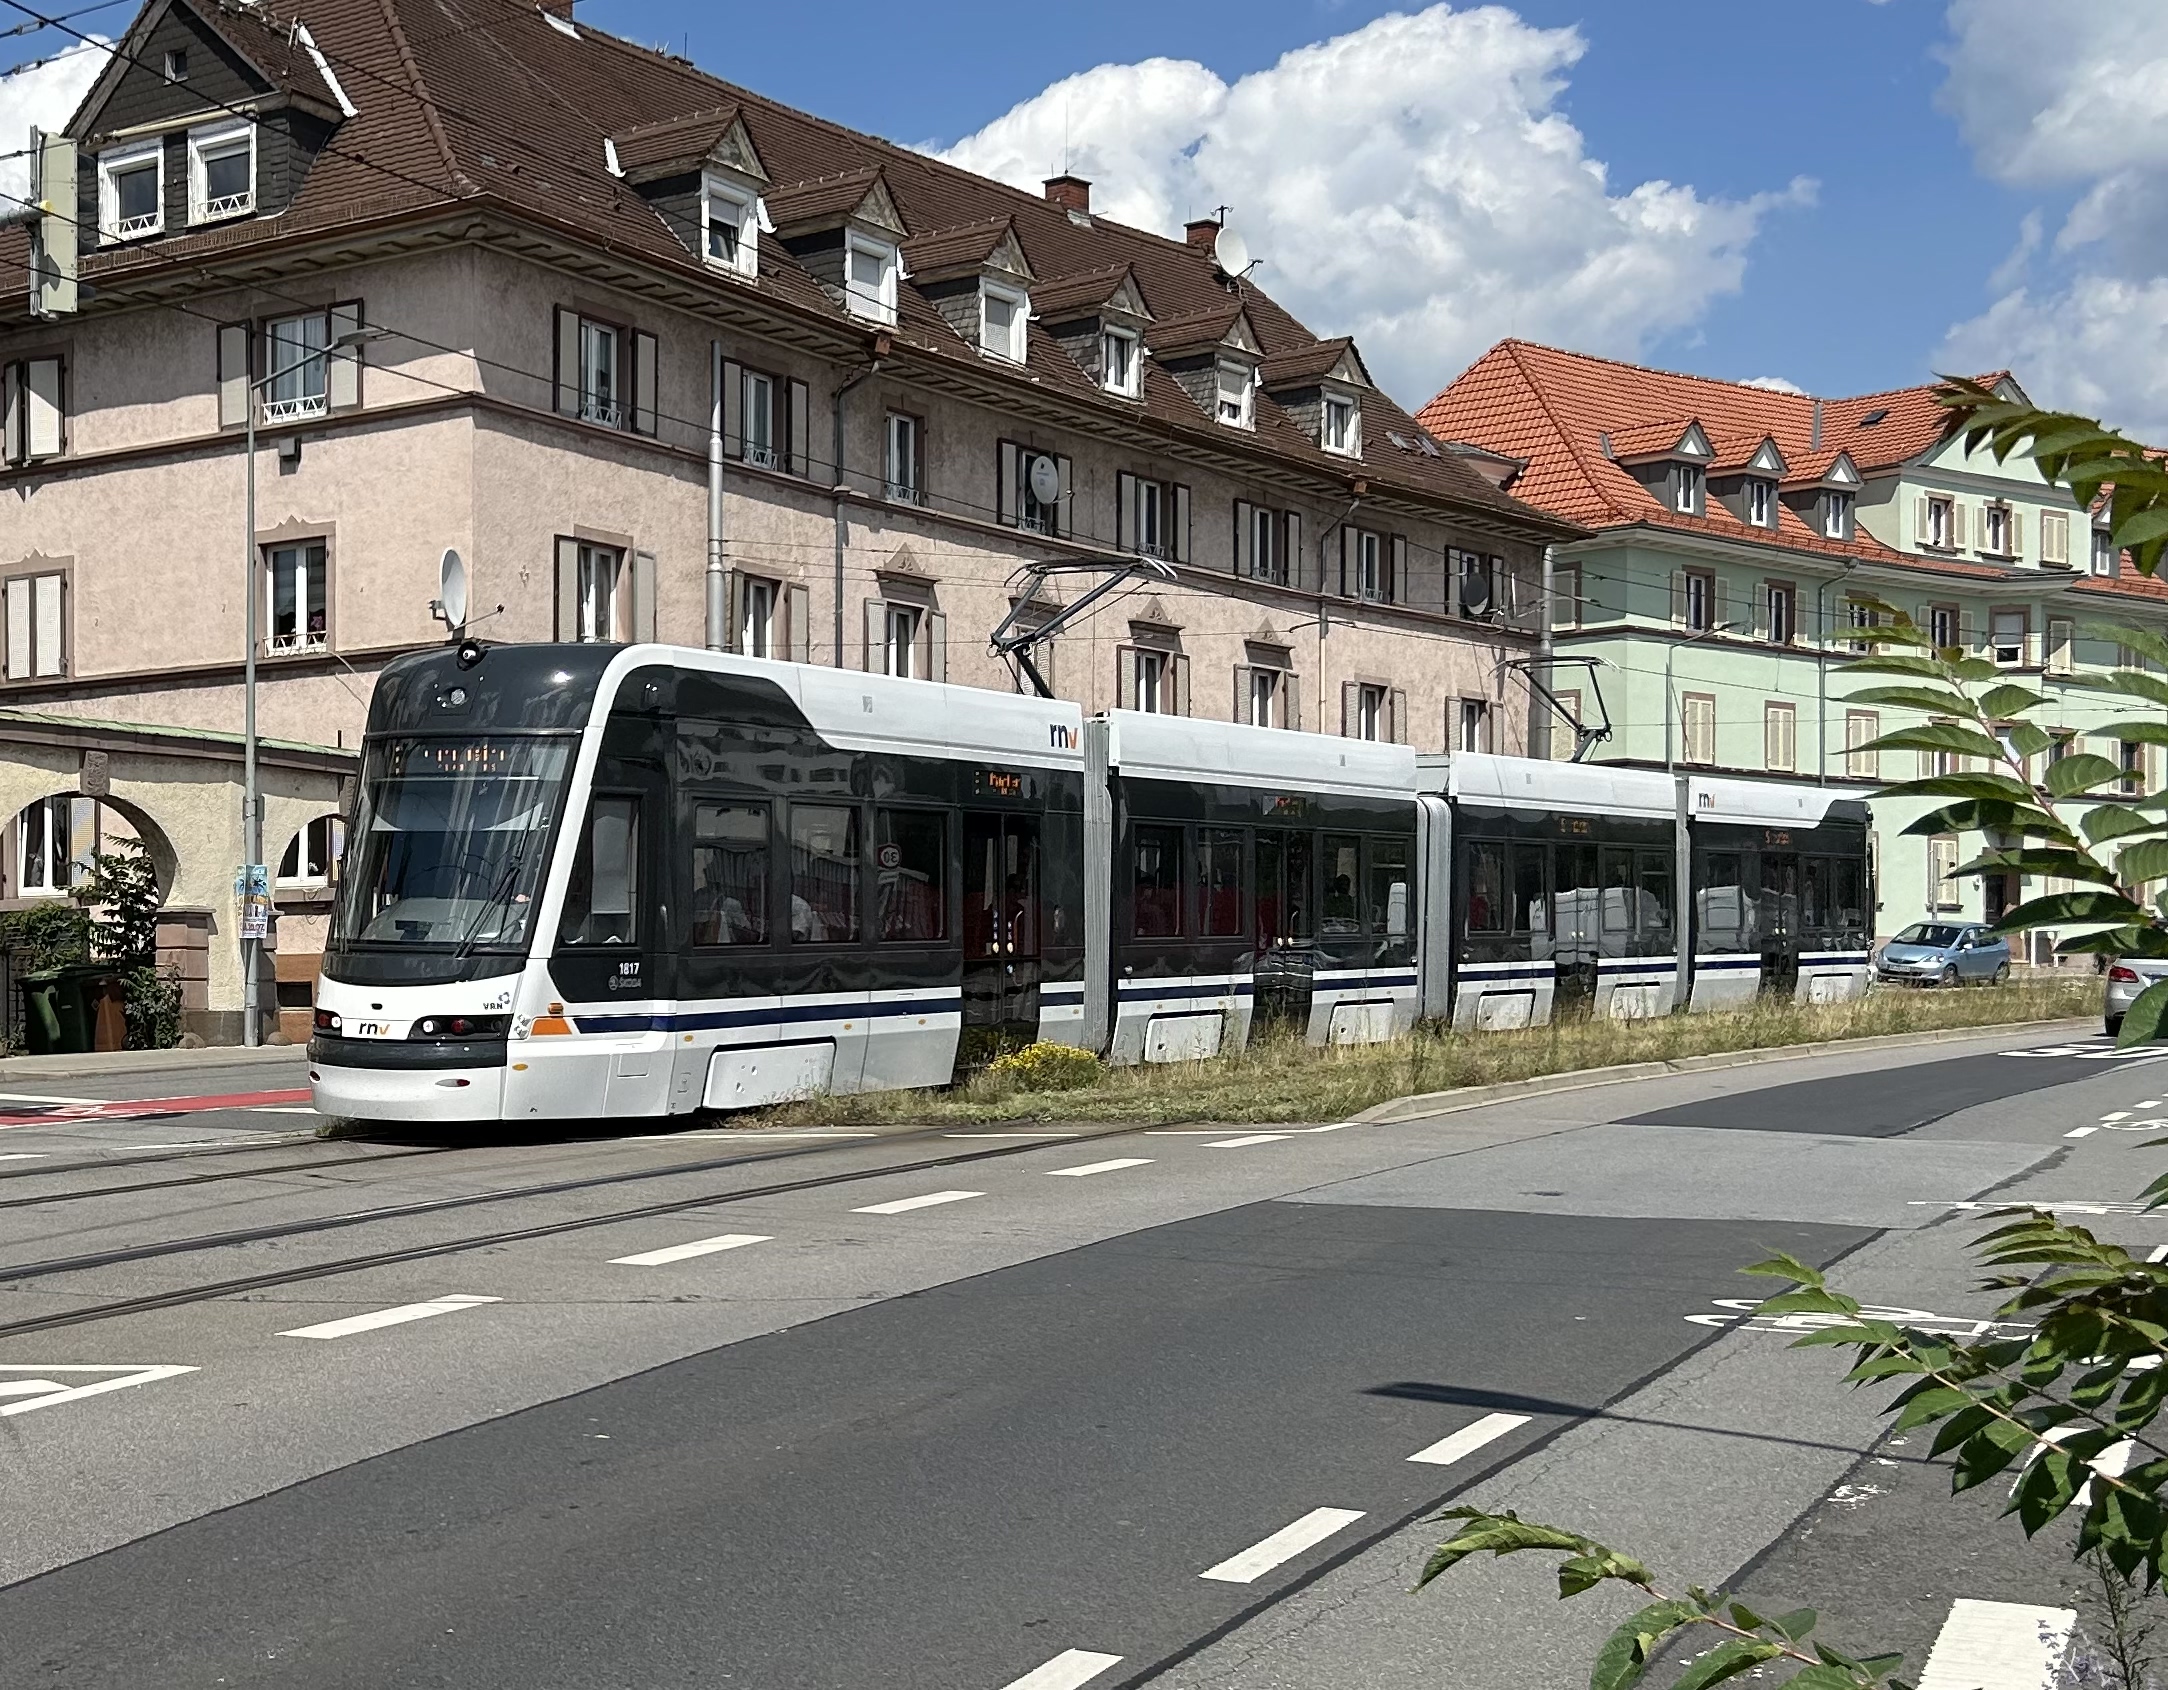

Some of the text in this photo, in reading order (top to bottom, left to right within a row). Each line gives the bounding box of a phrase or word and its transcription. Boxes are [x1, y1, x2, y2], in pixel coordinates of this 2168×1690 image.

[1049, 724, 1078, 749] rnv
[619, 962, 640, 975] 1817
[358, 1022, 390, 1035] rnv
